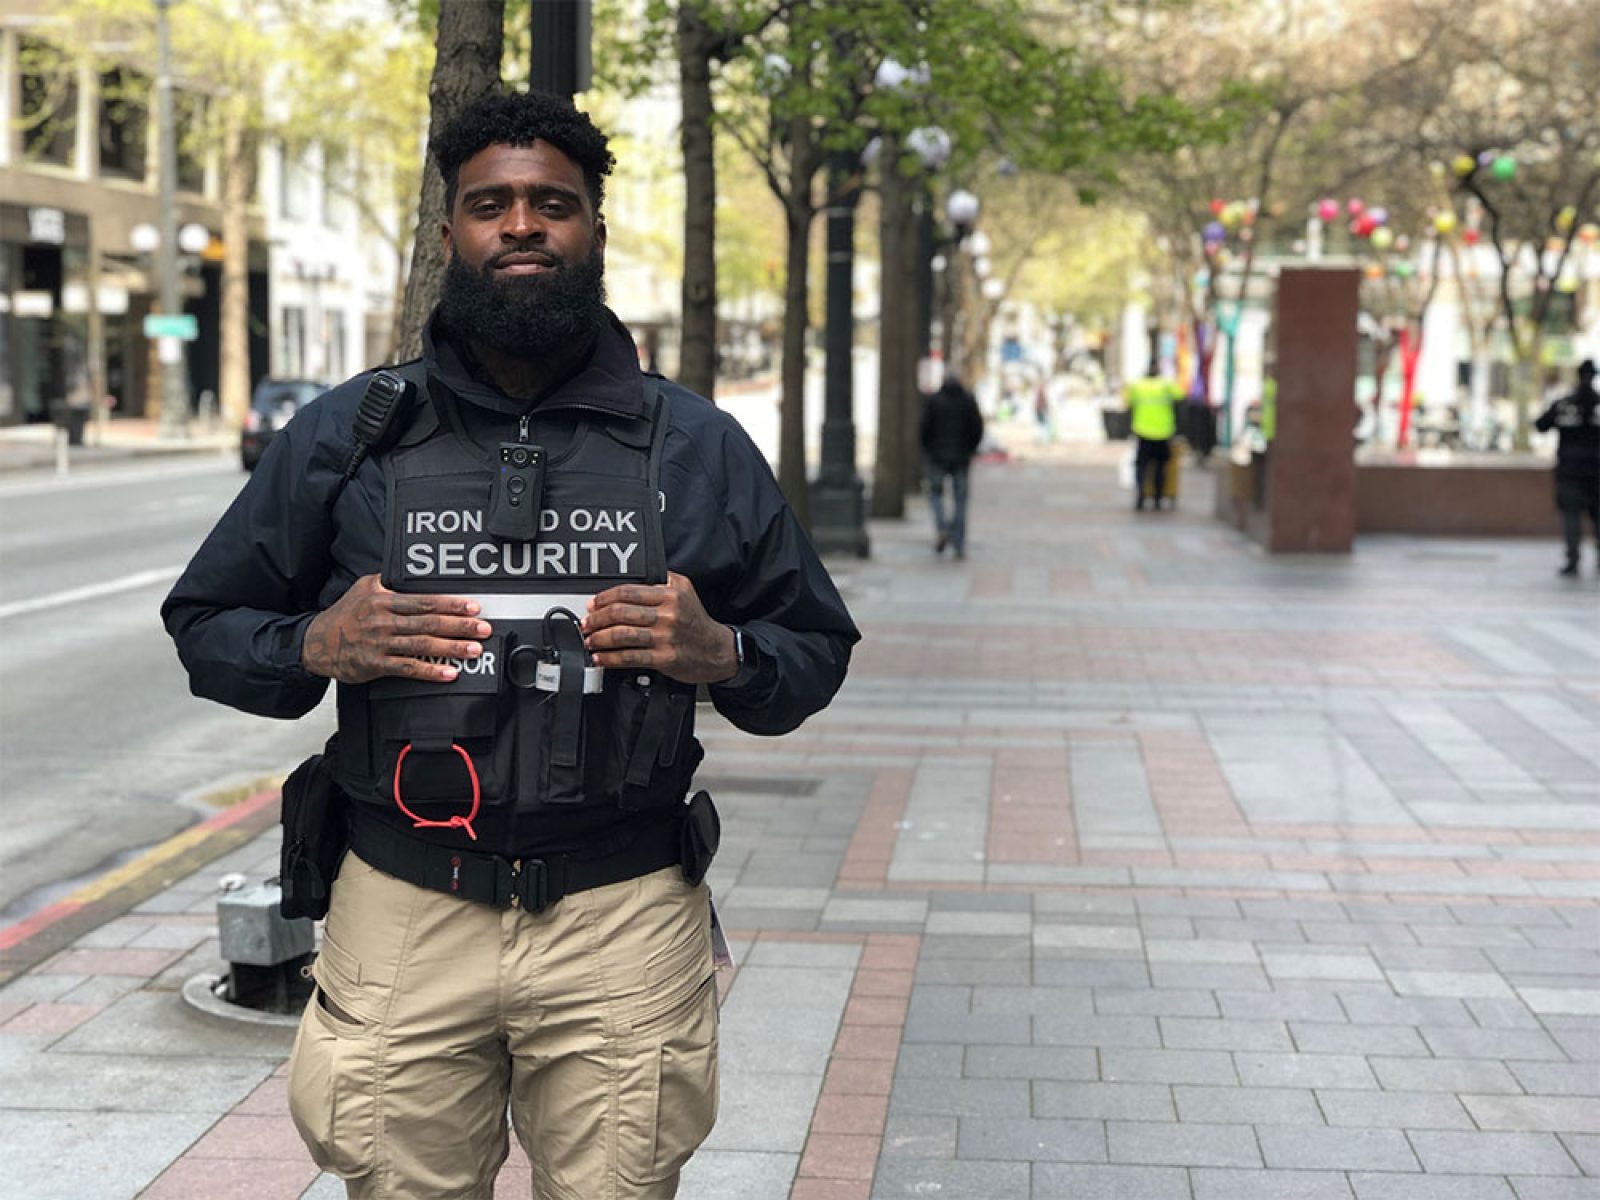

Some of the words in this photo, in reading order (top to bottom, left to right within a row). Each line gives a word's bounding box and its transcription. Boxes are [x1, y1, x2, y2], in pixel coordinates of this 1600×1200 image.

[406, 510, 483, 534] IRON
[570, 509, 638, 532] OAK
[406, 542, 638, 575] SECURITY
